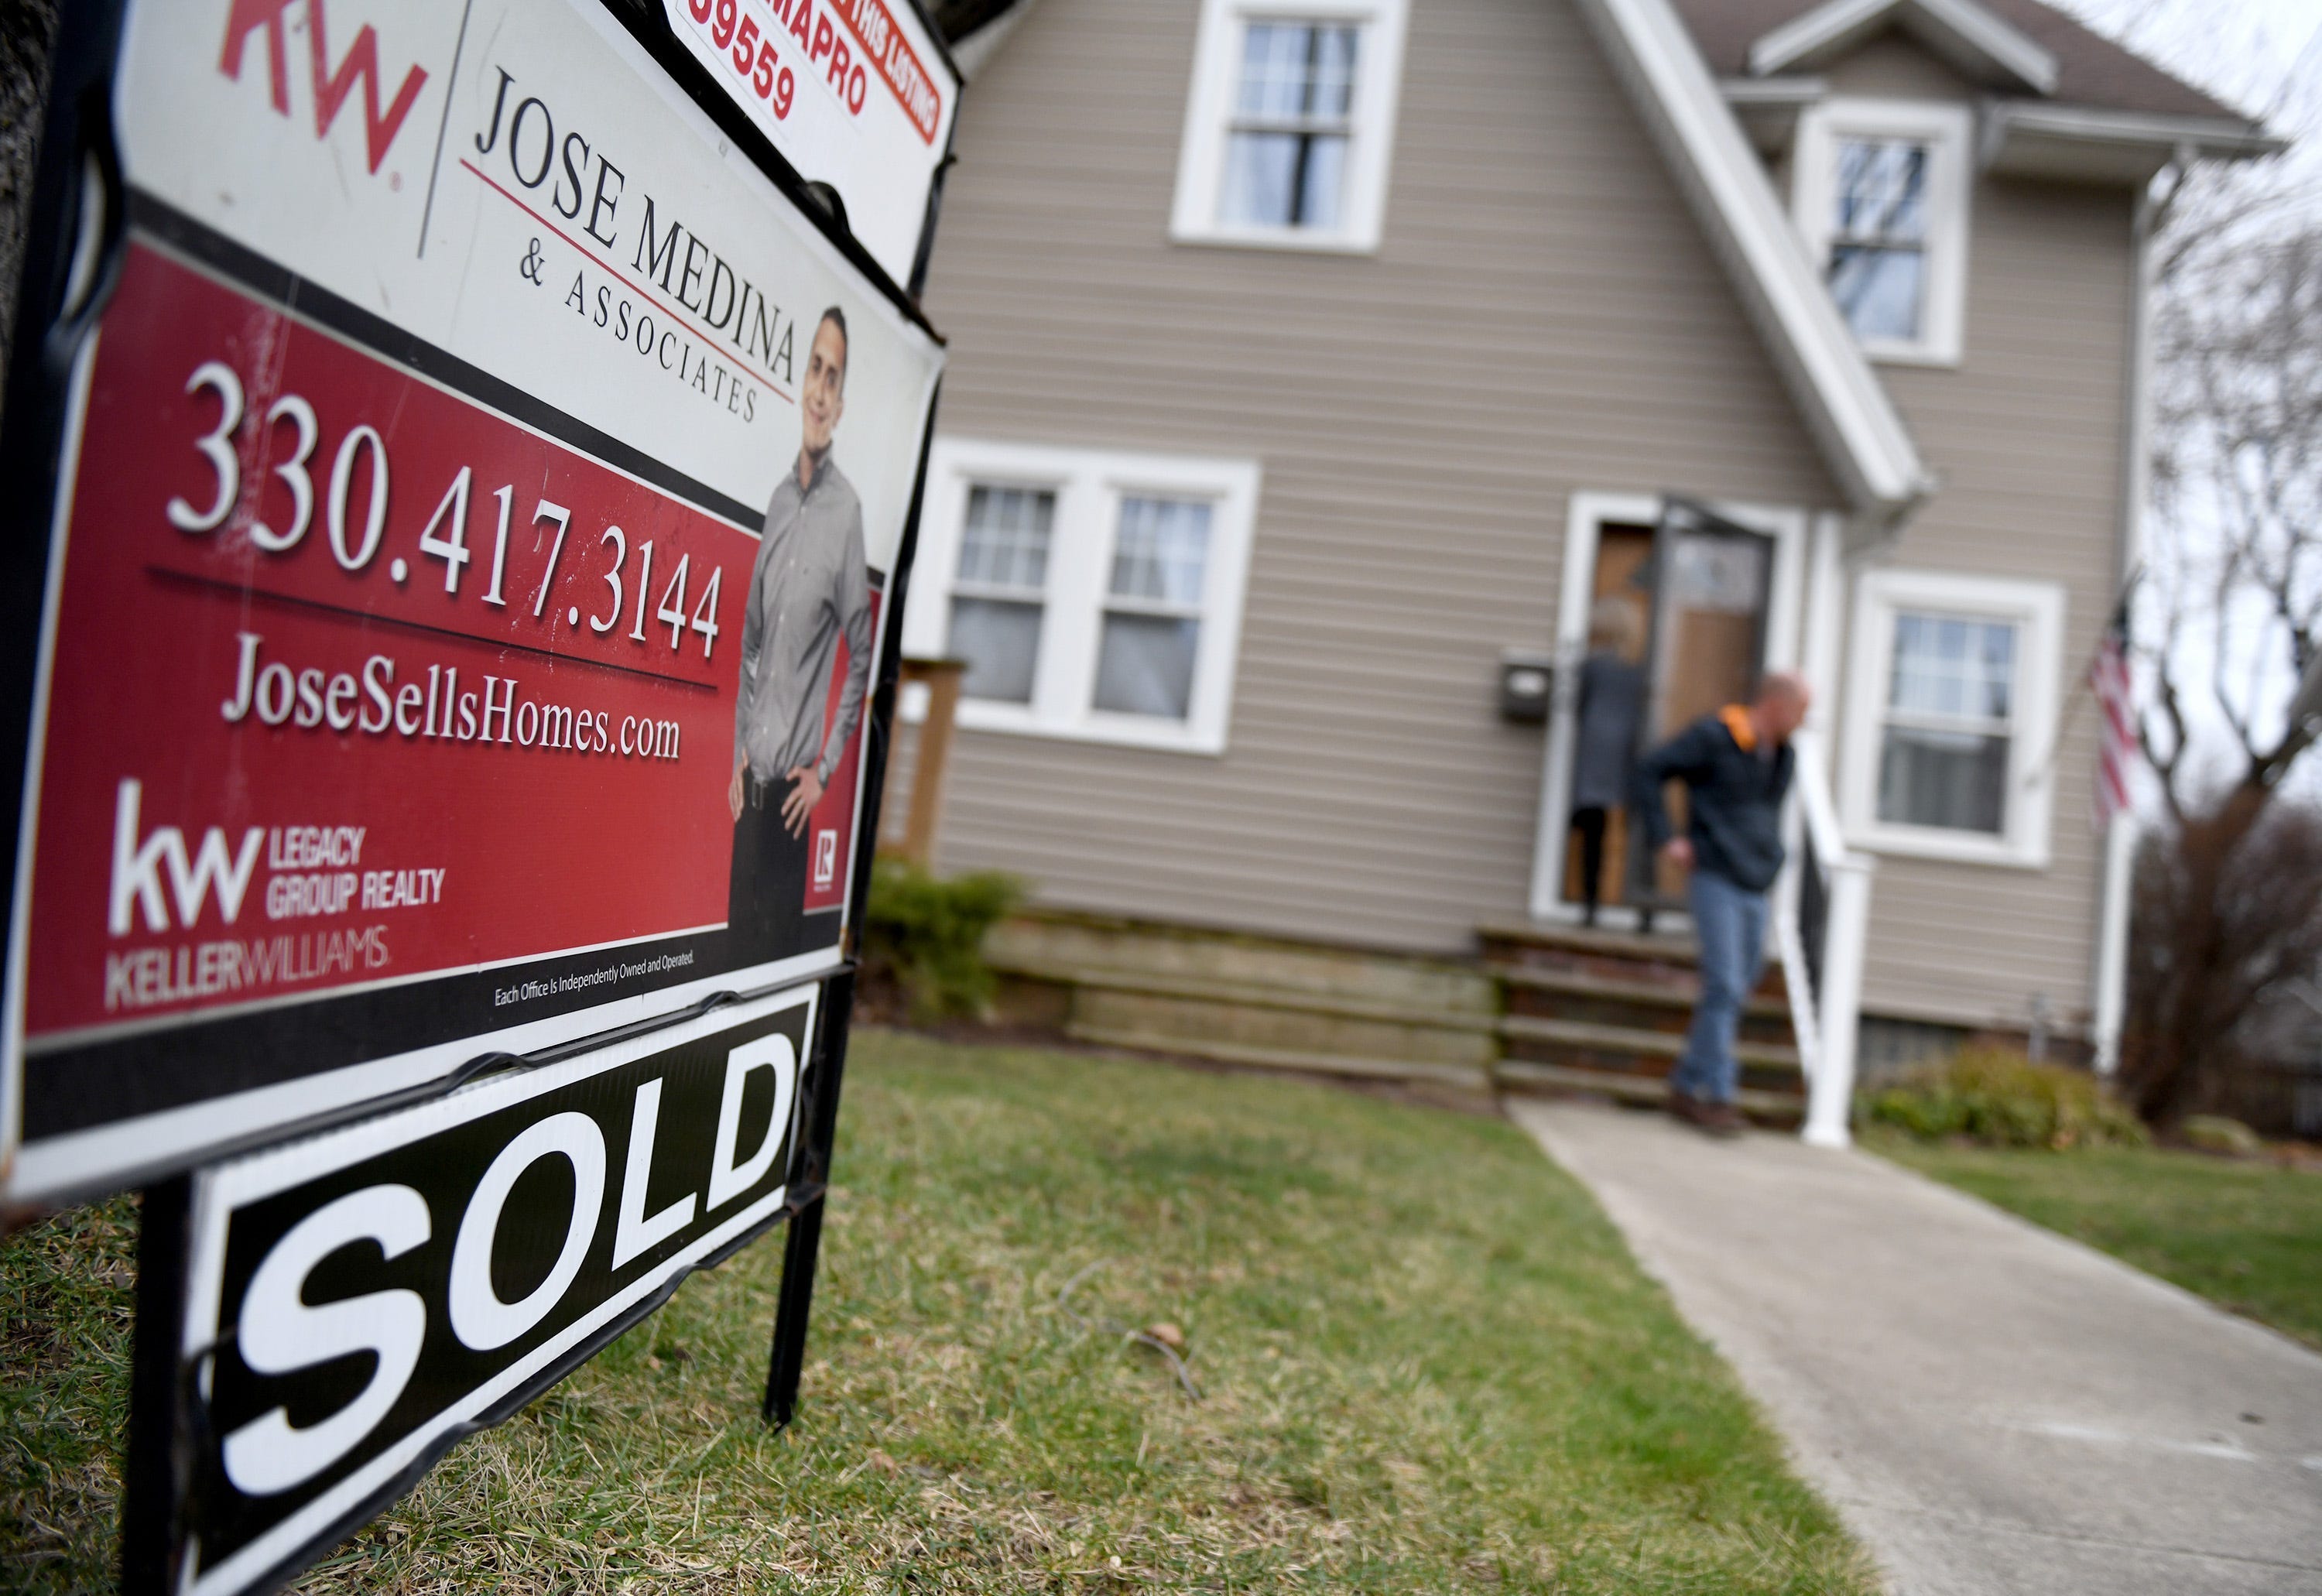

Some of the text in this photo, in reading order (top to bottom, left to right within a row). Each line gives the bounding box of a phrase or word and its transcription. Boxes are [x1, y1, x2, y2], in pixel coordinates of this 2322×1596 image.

[884, 34, 937, 135] LISTING
[475, 65, 794, 385] JOSE MEDINA
[520, 238, 757, 423] & ASSOCIATES
[166, 361, 722, 659] 330.417.3144
[221, 632, 680, 759] JoseSellsHomes.com
[267, 868, 446, 920] GROUP REALTY
[269, 827, 366, 869] LEGACY
[495, 950, 694, 1006] Each Office Is Independently Owned and Operated.
[223, 1033, 796, 1496] SOLD
